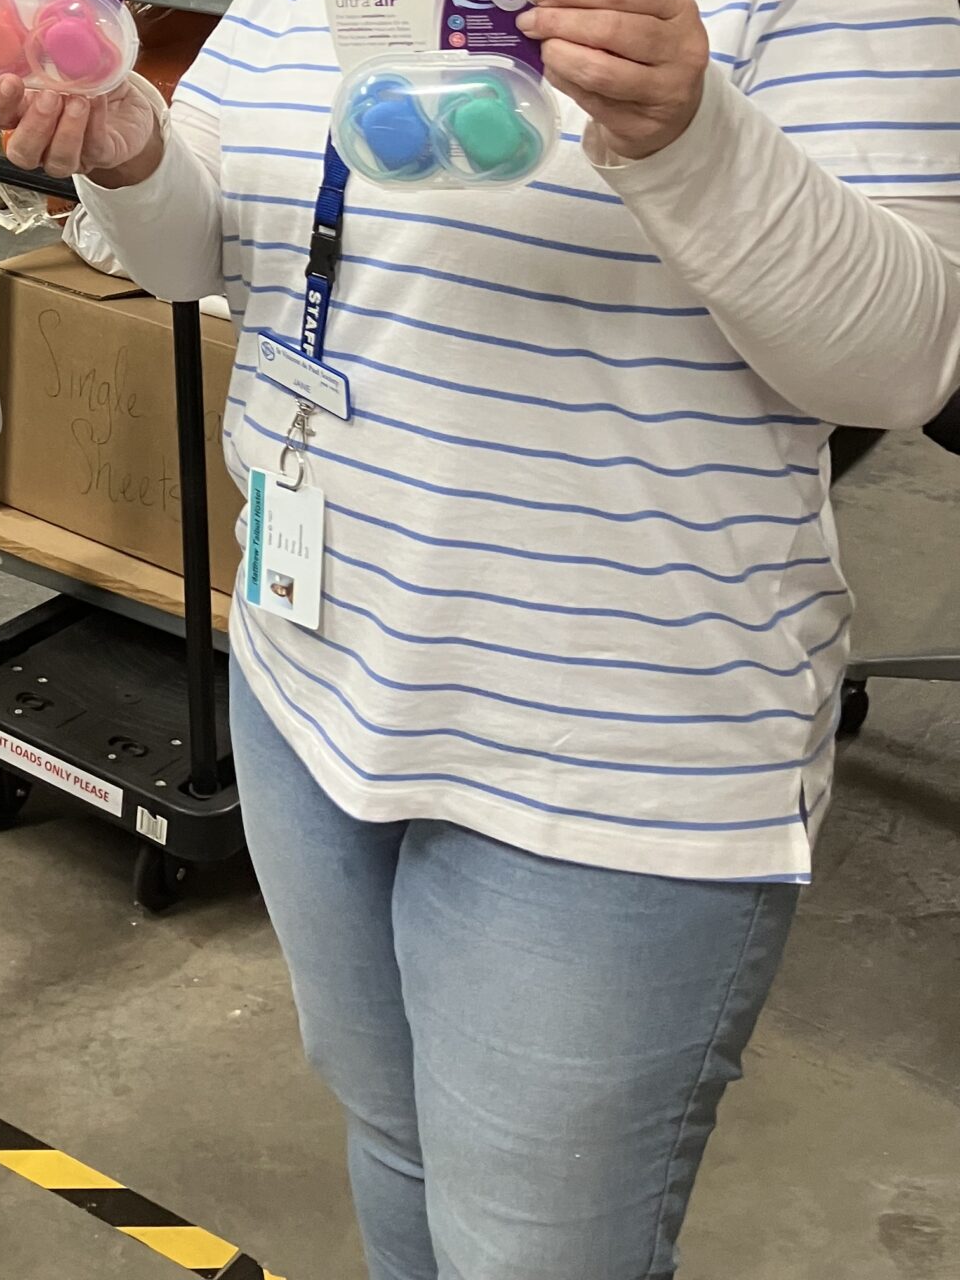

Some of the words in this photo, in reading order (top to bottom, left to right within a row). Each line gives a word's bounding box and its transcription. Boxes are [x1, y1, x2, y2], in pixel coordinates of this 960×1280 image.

[303, 289, 322, 358] STAFF
[254, 488, 262, 518] Hostel
[10, 738, 43, 767] LOADS
[44, 760, 72, 782] ONLY
[73, 775, 110, 803] PLEASE
